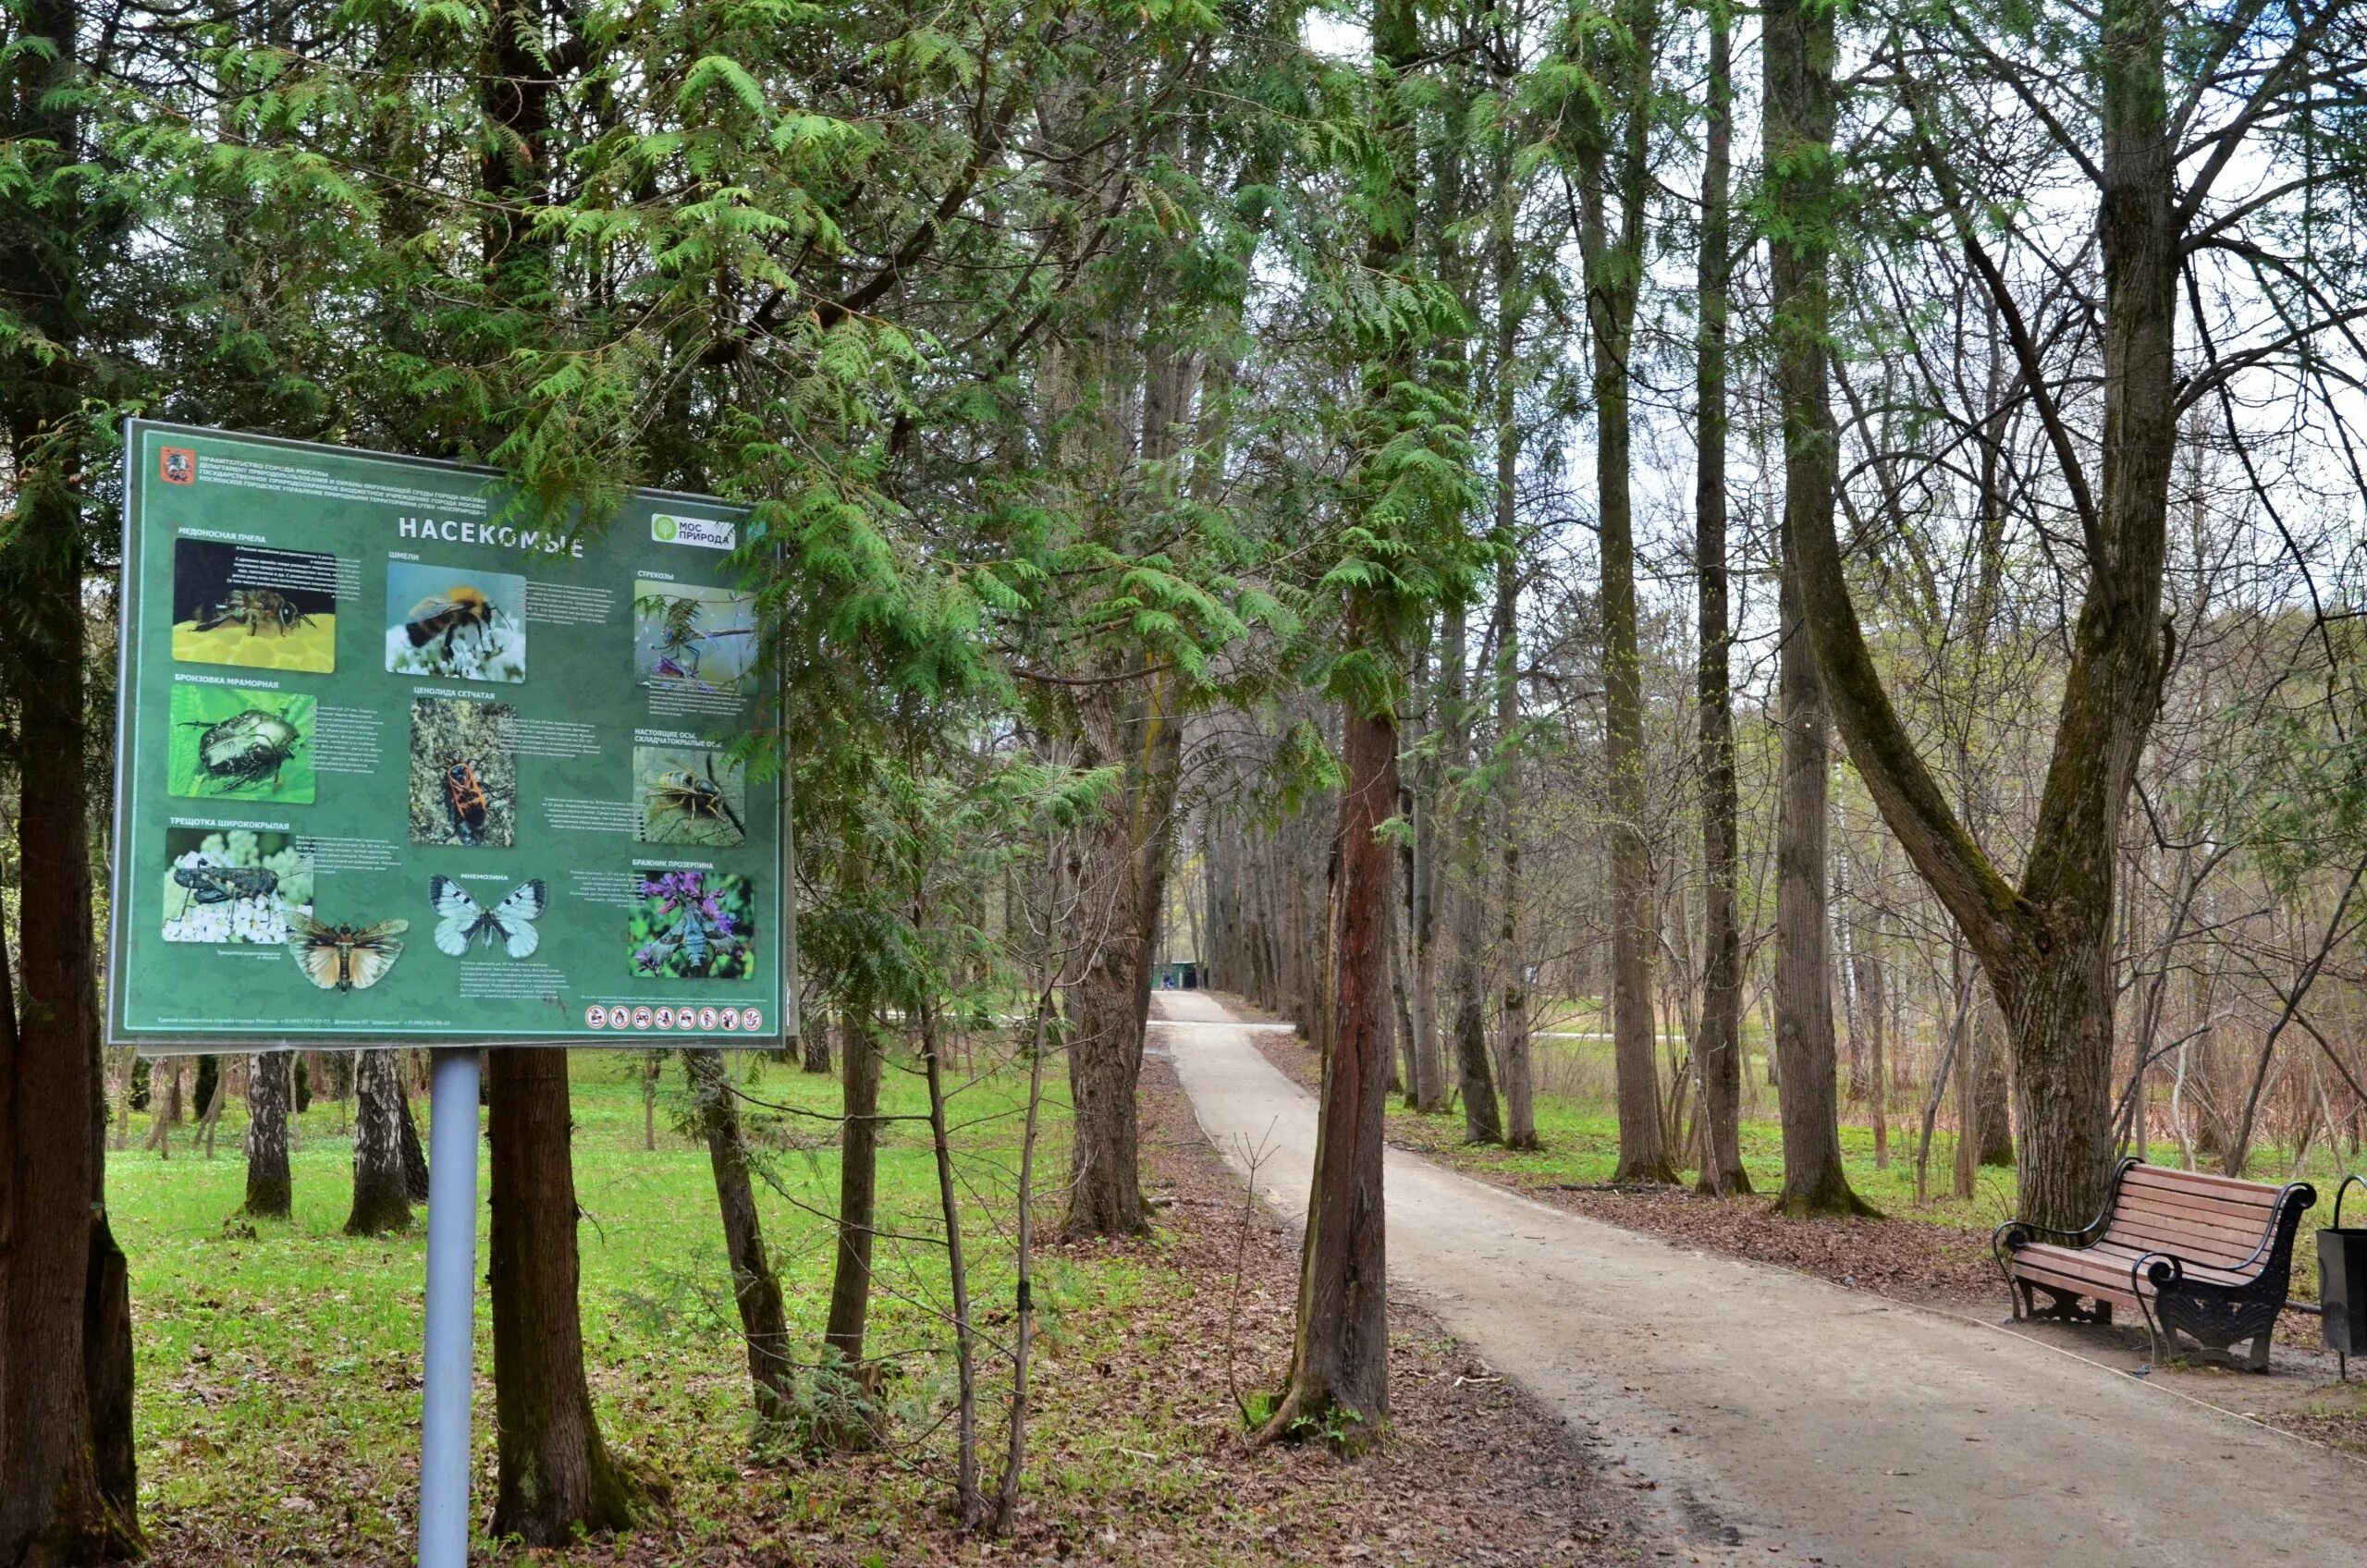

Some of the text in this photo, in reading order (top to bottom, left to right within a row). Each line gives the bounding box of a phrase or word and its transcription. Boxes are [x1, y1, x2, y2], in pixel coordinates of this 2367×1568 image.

[200, 456, 328, 477] ПРАВИТЕЛЬСТВО ГОРОДА МОСКВЫ
[199, 462, 248, 473] ДЕПАРТАМЕНТ
[249, 469, 328, 484] ПРИРОДОПОЛЬЗОВАНИЯ
[337, 479, 362, 488] ОХРАНЫ
[363, 483, 411, 495] ОКРУЖАЮЩЕЙ
[412, 489, 434, 497] СРЕДЫ
[435, 492, 460, 501] ГОРОДА
[460, 495, 486, 504] МОСКВЫ
[199, 469, 486, 510] ГОСУДАРСТВЕННОЕ ПРИРОДООХРАННОЕ БЮДЖЕТНОЕ УЧРЕЖДЕНИЕ ГОРОДА МОСКВЫ
[199, 476, 243, 486] МОСКОВСКОЕ
[244, 481, 281, 491] ГОРОДСКОЕ
[282, 485, 323, 496] УПРАВЛЕНИЕ
[325, 491, 368, 502] ПРИРОДНЫМИ
[370, 496, 417, 508] ТЕРРИТОРИЯМИ
[680, 522, 702, 533] МОС
[178, 527, 266, 543] МЕДОНОСНАЯ ПЧЕЛА
[399, 517, 583, 558] НАСЕКОМЫЕ
[679, 531, 730, 545] ПРИРОДА
[388, 551, 420, 561] ШМЕЛИ
[637, 570, 674, 581] СТРЕКОЗЫ
[175, 674, 279, 688] БРОНЗОВКА МРАМОРНАЯ
[413, 686, 496, 700] ЦЕНОЛИДА СЕТЧАТАЯ
[634, 729, 678, 738] НАСТОЯЩИЕ
[634, 735, 705, 747] СКЛАДЧАТОКРЫЛЫЕ
[170, 817, 289, 829] ТРЕЩОТКА ШИРОКОКРЫЛАЯ
[632, 859, 714, 869] БРАЖНИК ПРОЗЕРПИНА
